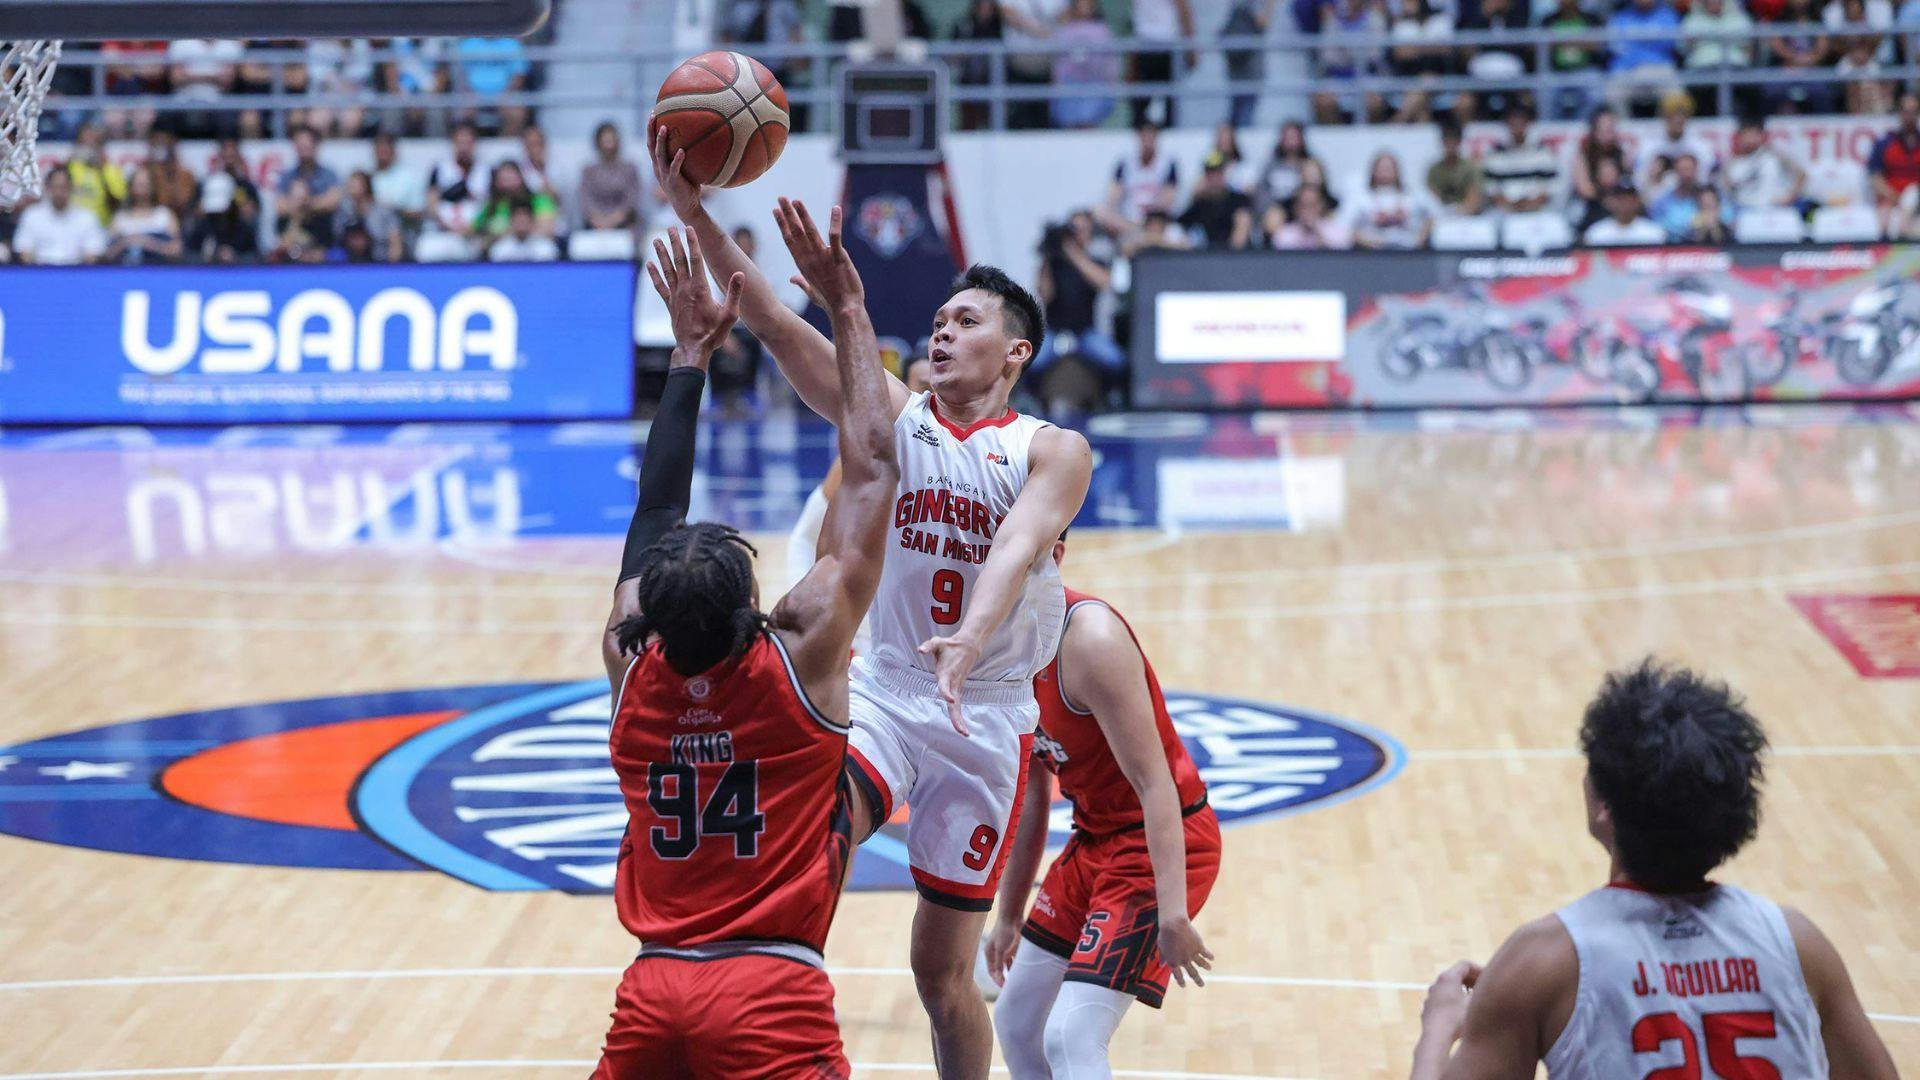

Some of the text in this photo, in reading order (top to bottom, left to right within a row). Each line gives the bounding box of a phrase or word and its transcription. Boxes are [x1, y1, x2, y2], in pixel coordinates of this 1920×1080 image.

[122, 286, 518, 375] USANA
[895, 489, 1005, 540] GINEBR
[900, 527, 939, 555] SAN
[931, 568, 965, 625] 9
[671, 731, 735, 764] KING
[647, 759, 766, 861] 94
[963, 824, 999, 872] 9
[1633, 960, 1658, 998] J.
[1632, 1011, 1784, 1080] 25
